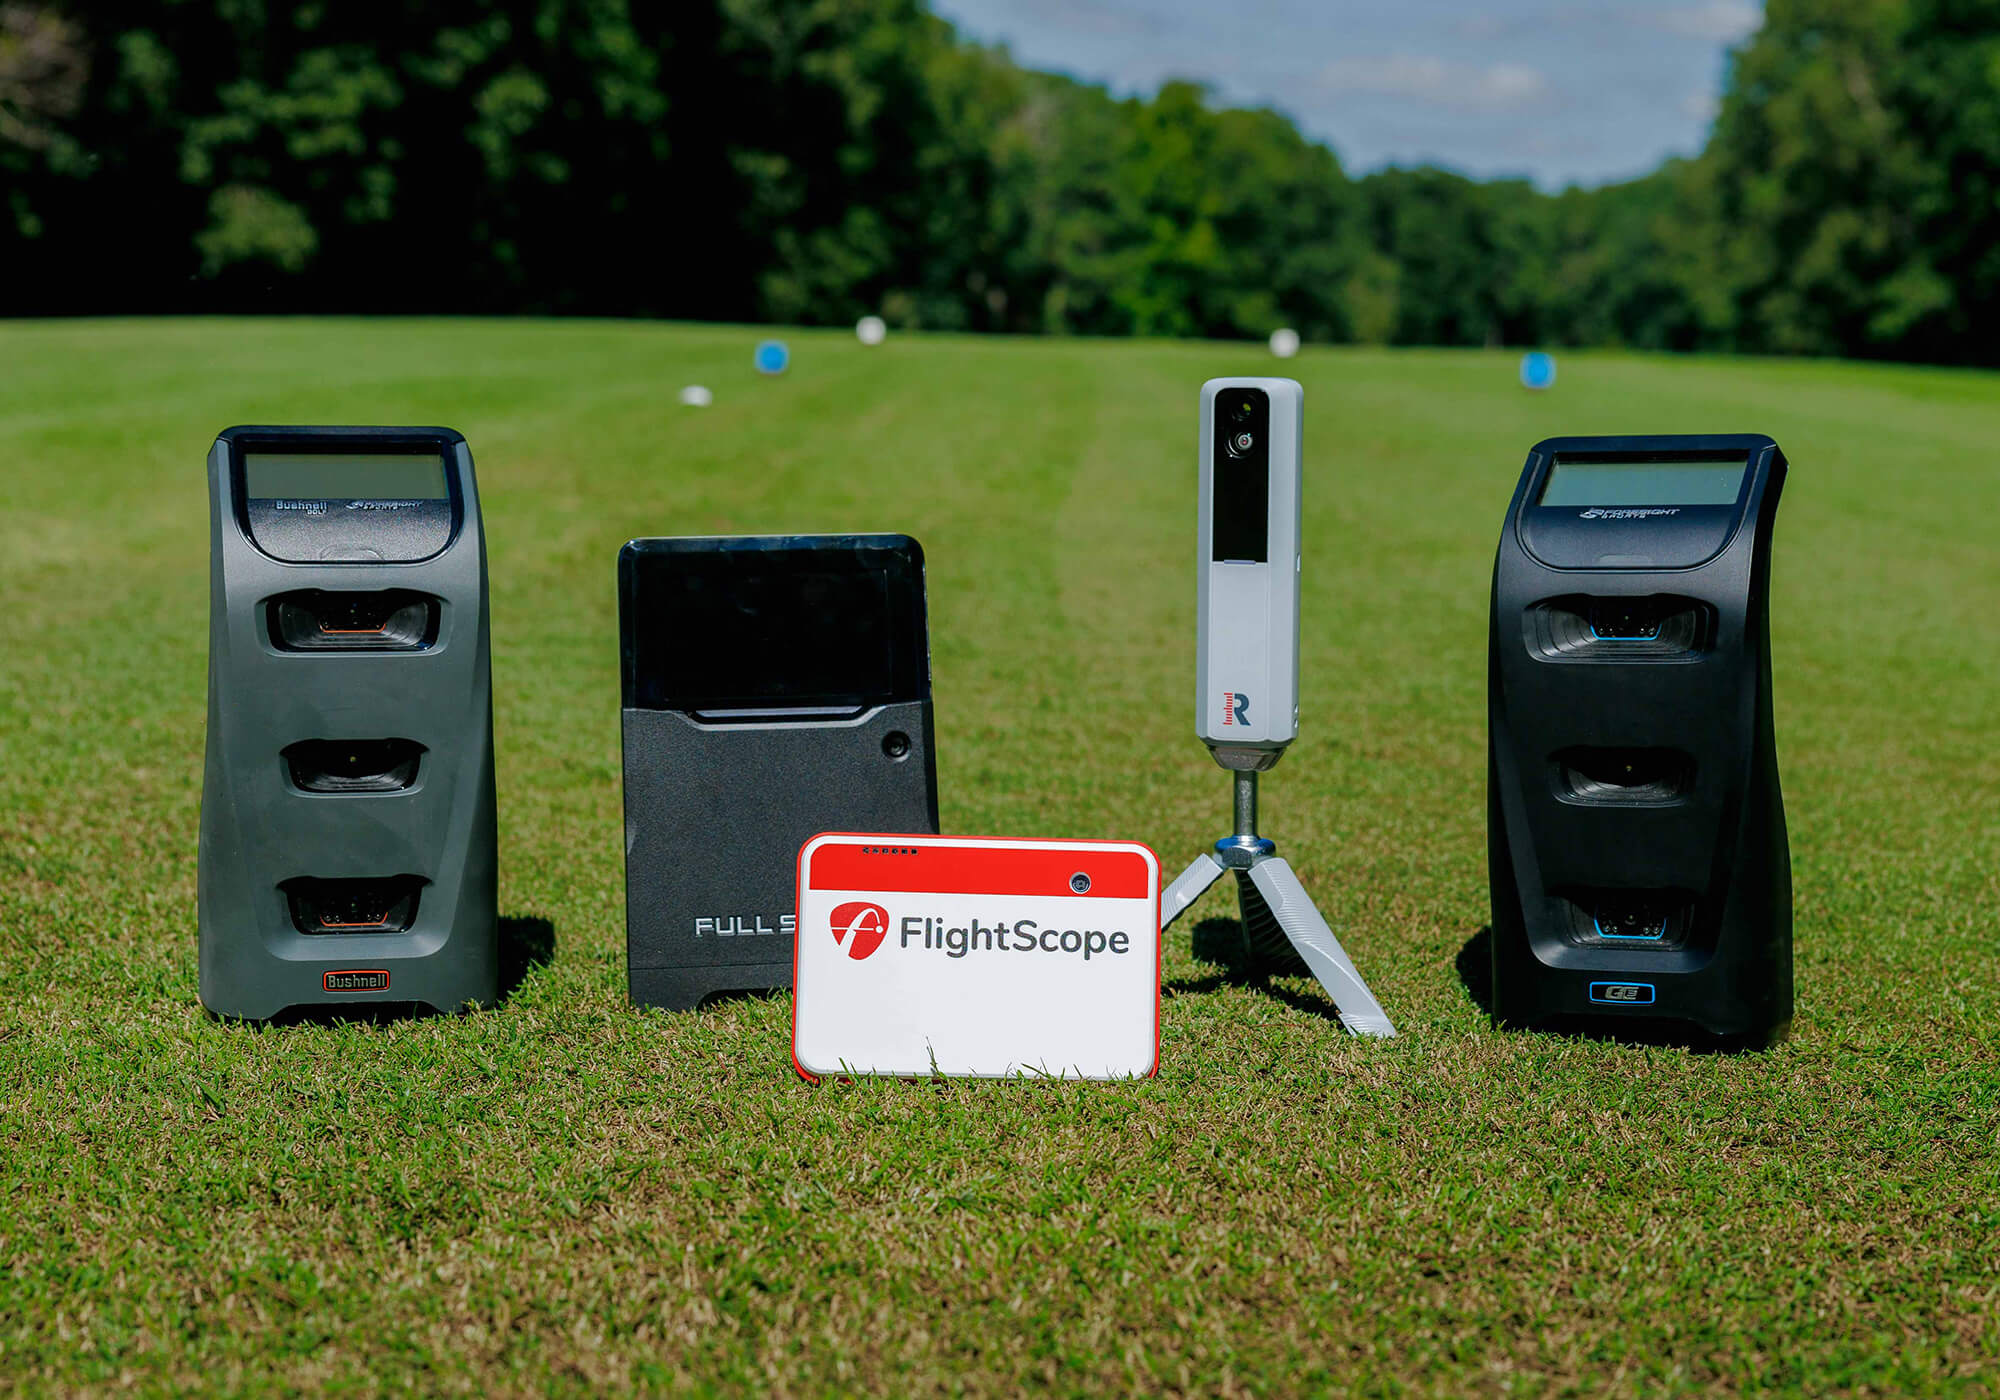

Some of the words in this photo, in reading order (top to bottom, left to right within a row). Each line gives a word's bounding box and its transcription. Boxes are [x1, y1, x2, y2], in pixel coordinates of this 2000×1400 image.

[275, 501, 327, 510] Bushnell
[695, 915, 775, 937] FULL
[901, 917, 1130, 961] FlightScope
[327, 974, 386, 988] Bushnell
